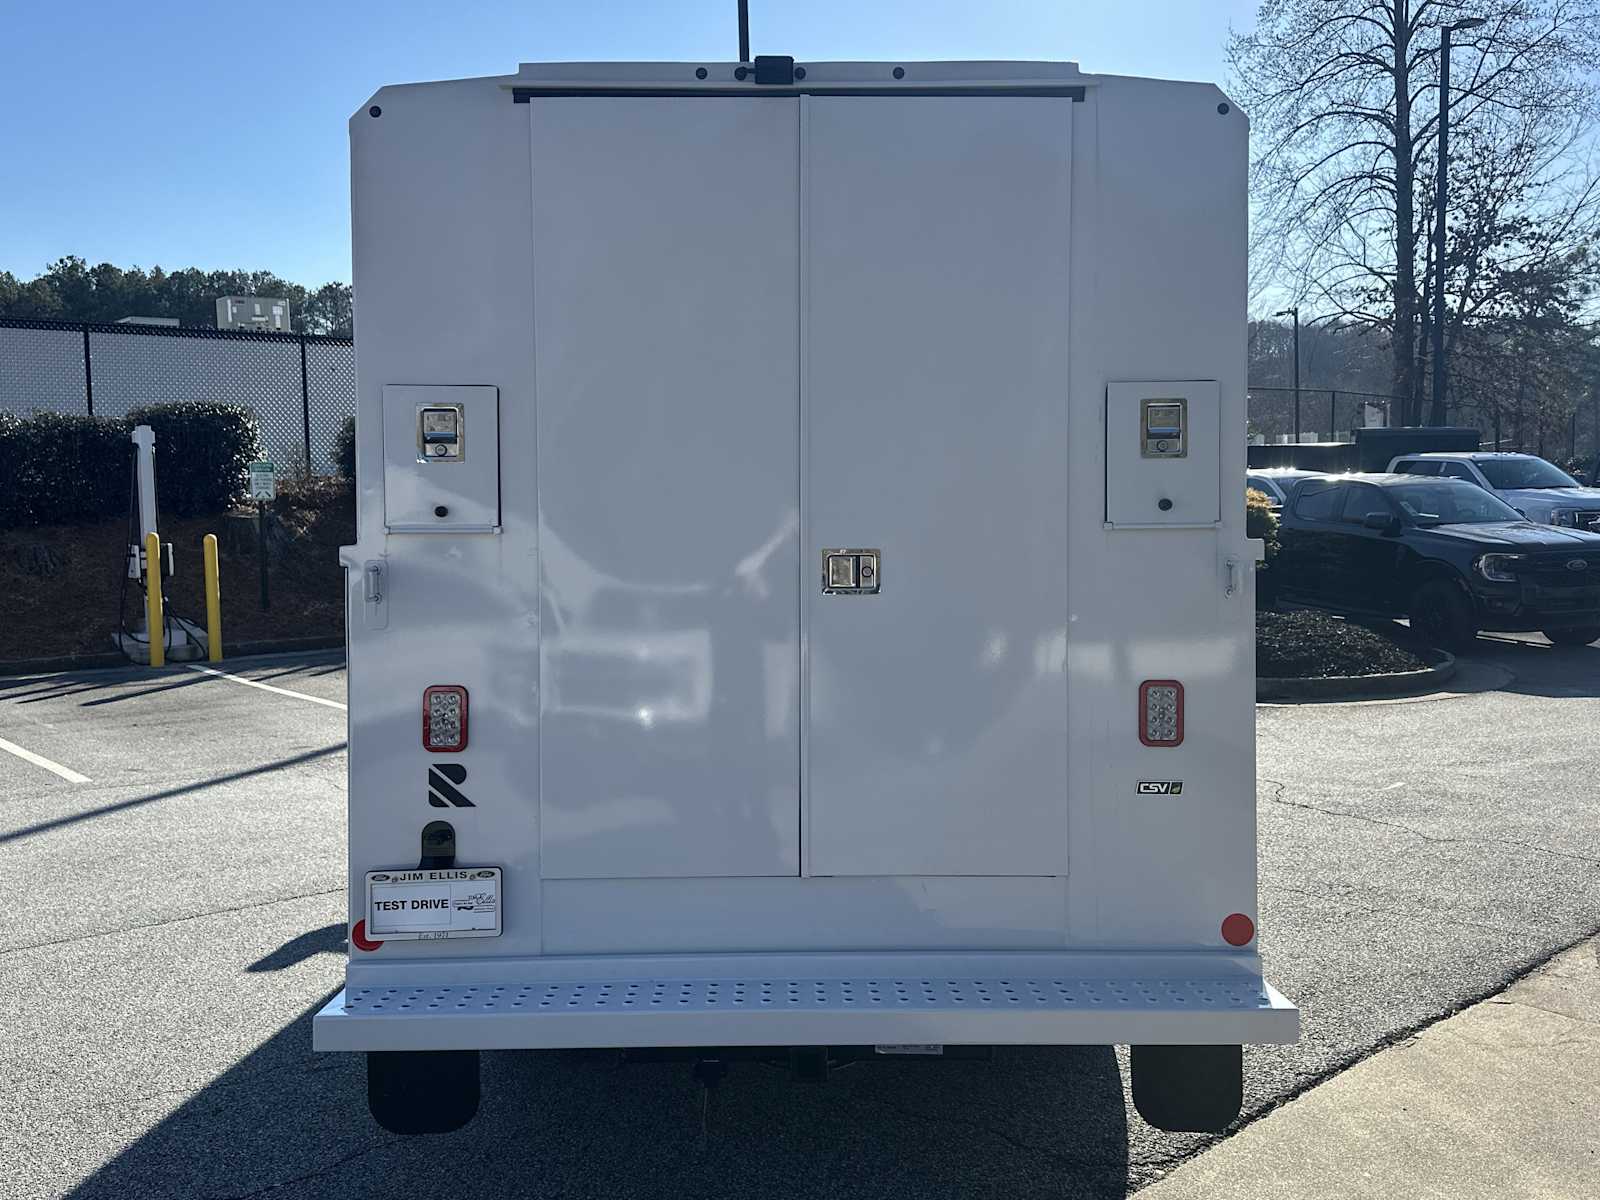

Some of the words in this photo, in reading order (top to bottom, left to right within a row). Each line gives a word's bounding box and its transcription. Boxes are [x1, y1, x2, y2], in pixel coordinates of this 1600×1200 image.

[1139, 782, 1168, 793] CSV
[399, 872, 424, 881] JIM
[429, 871, 468, 880] ELLIS
[374, 900, 408, 911] TEST
[411, 899, 449, 910] DRIVE
